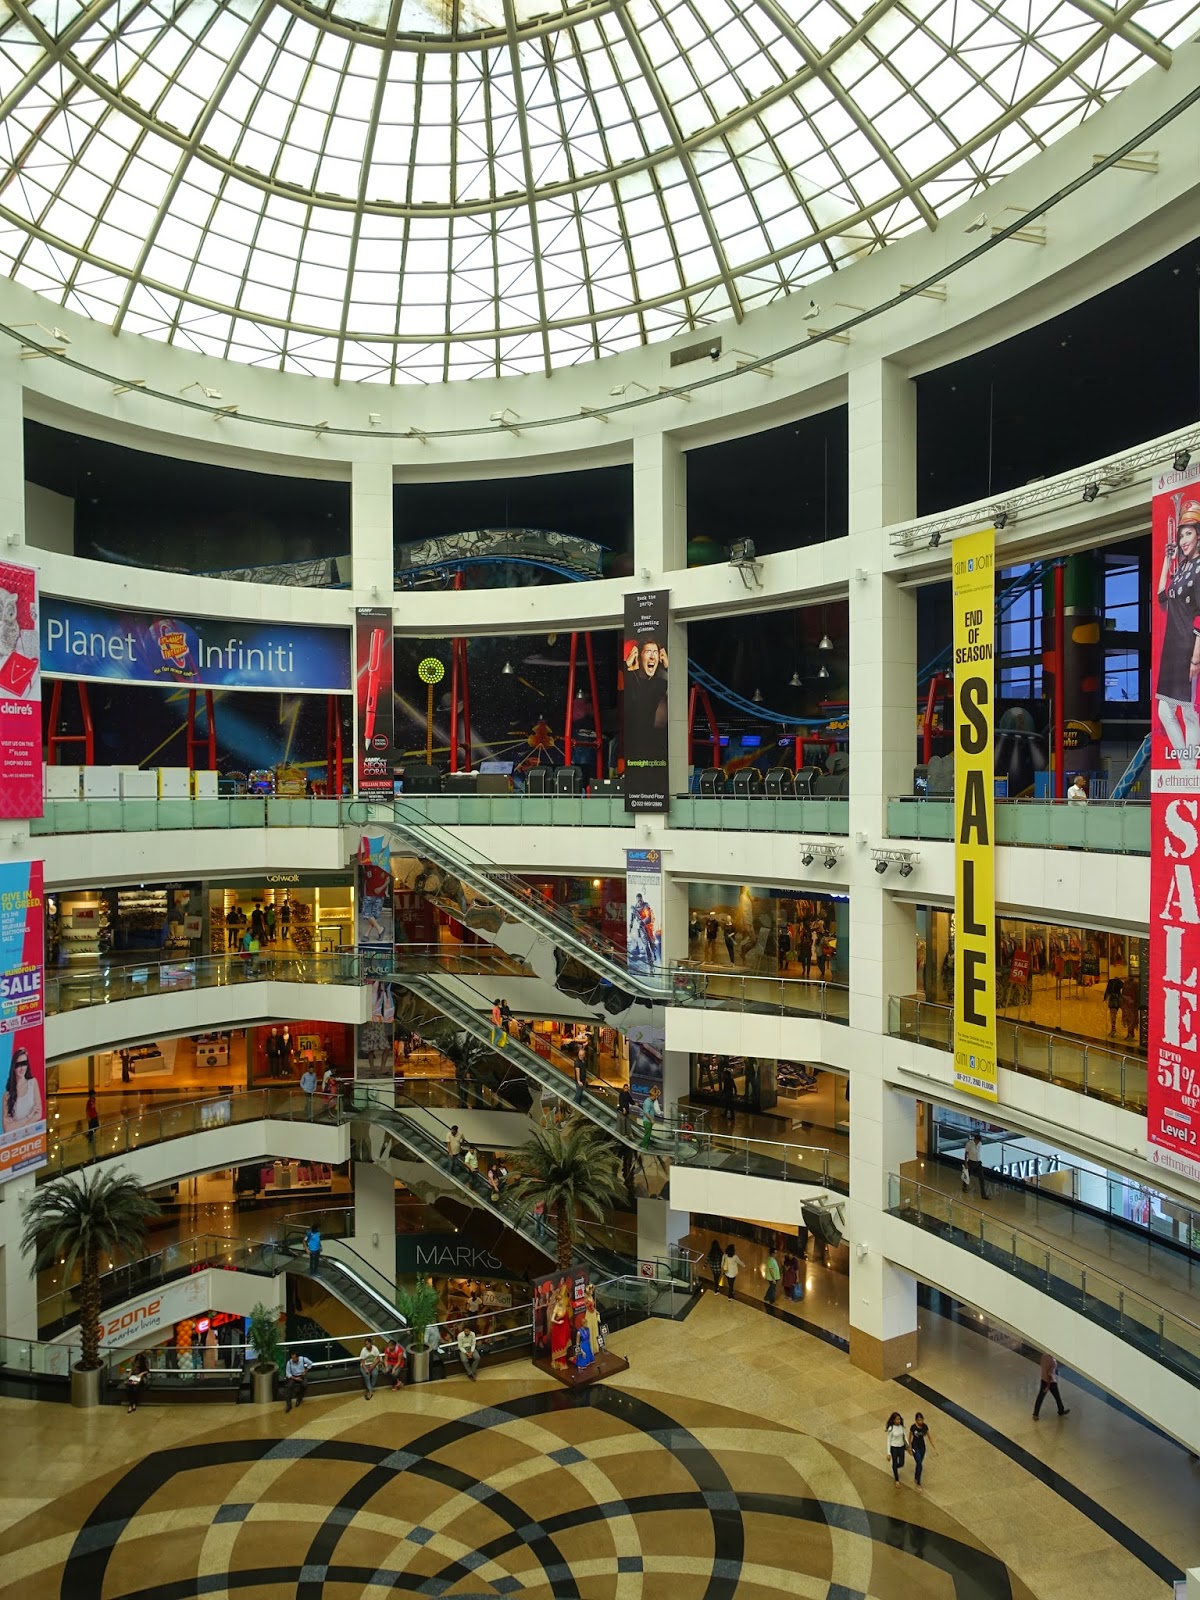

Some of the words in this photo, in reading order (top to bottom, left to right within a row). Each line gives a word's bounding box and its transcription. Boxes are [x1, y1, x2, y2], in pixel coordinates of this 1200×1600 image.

[965, 609, 983, 628] END
[47, 619, 137, 662] Planet
[199, 638, 294, 672] Infiniti
[968, 627, 980, 645] OF
[955, 643, 993, 664] SEASON
[1, 702, 33, 715] claire's
[1165, 745, 1192, 760] Level
[363, 768, 389, 776] CORAL
[1165, 775, 1200, 787] ethnicit
[960, 676, 989, 1027] SALE
[1, 892, 21, 902] GIVE
[23, 890, 32, 899] IN
[2, 901, 13, 911] TO
[15, 898, 42, 909] GREED.
[1159, 798, 1200, 1052] SALE
[1014, 961, 1028, 969] SALE
[0, 972, 41, 997] SALE
[1159, 1048, 1181, 1063] UPTO
[1157, 1059, 1200, 1098] 51%
[1160, 1119, 1188, 1142] Level
[1189, 1131, 1197, 1146] 2
[416, 1245, 502, 1269] MARKS
[107, 1326, 139, 1345] smarter
[141, 1317, 160, 1330] living
